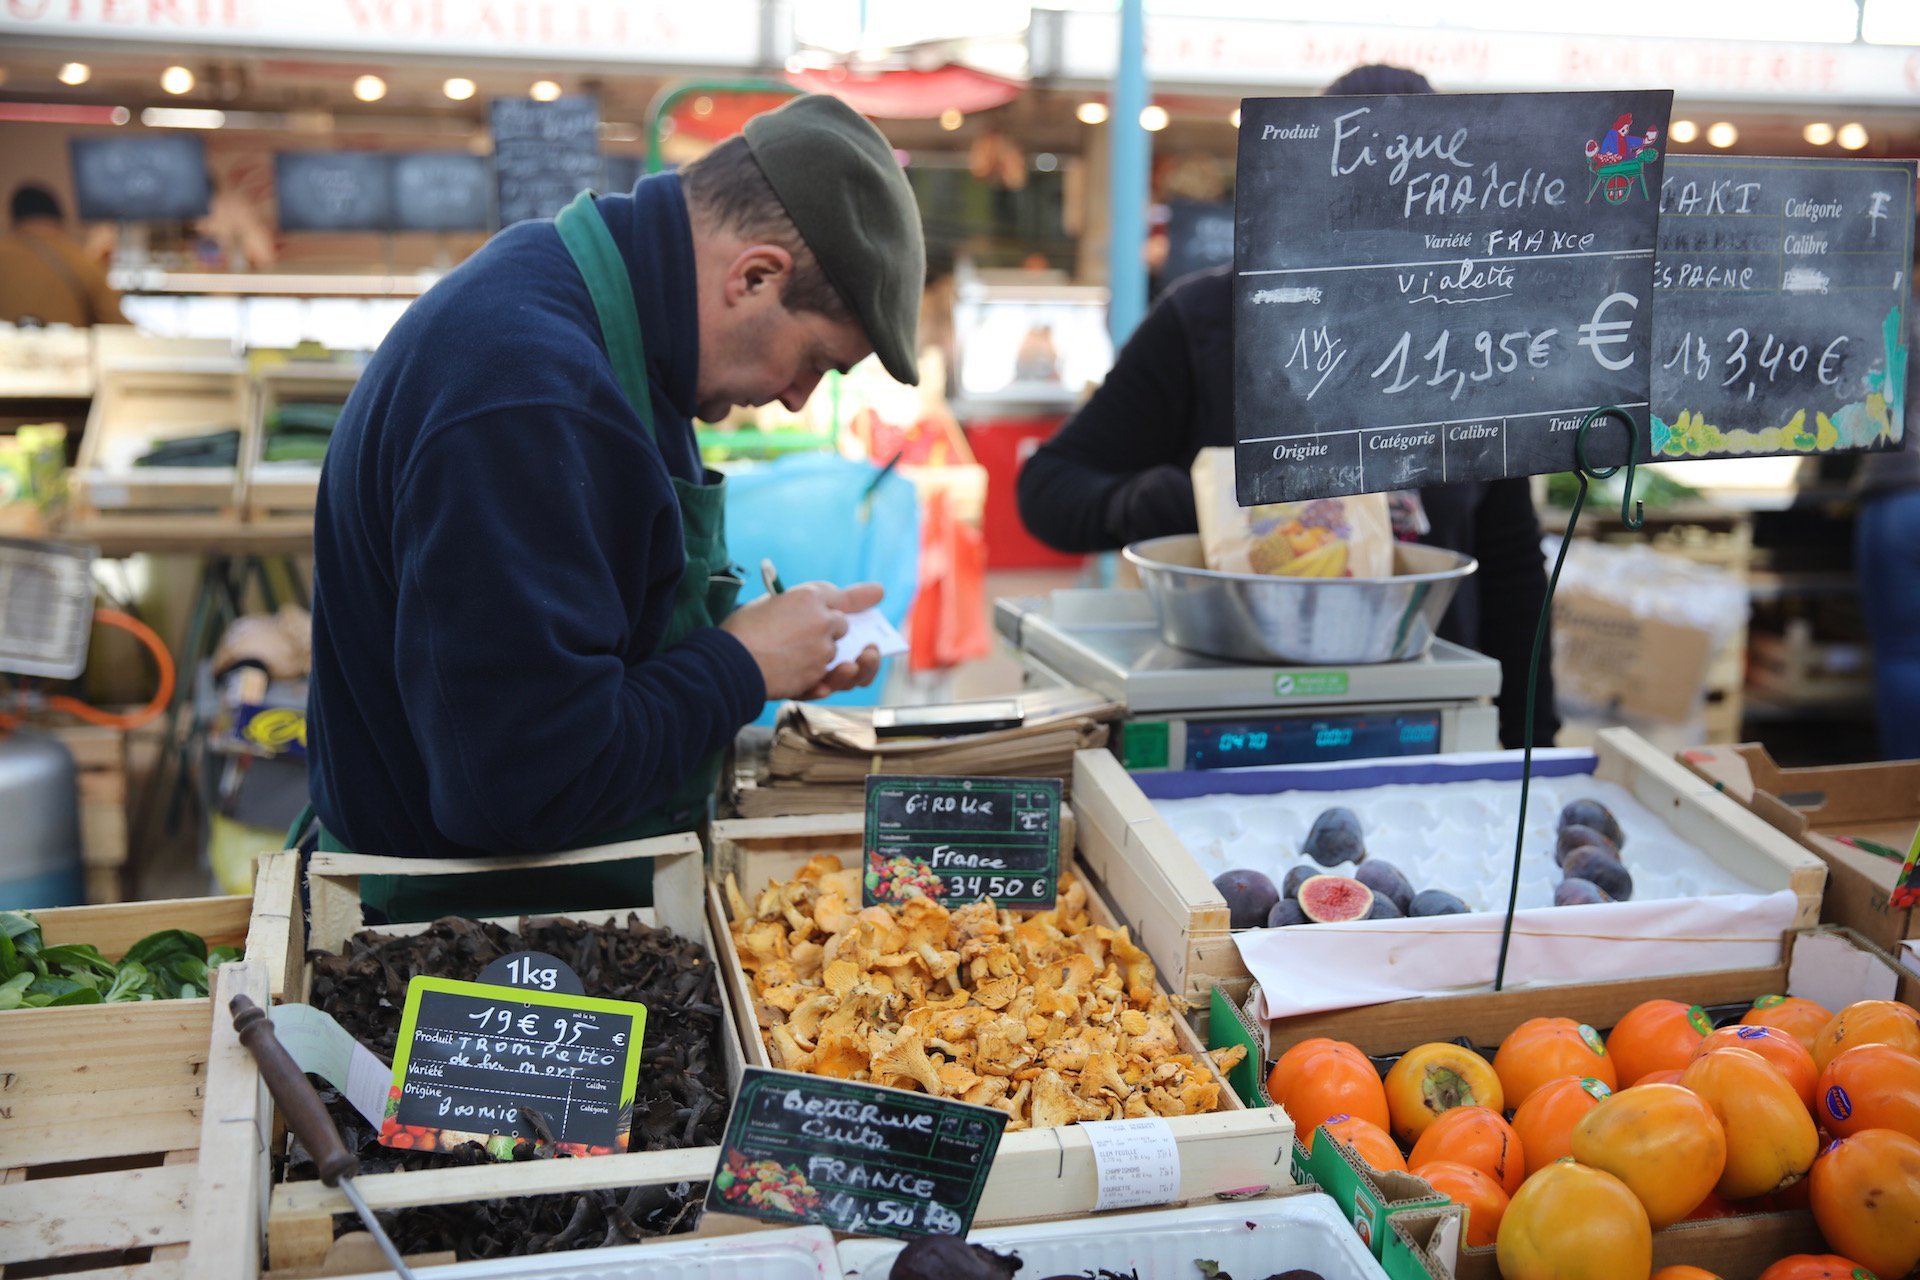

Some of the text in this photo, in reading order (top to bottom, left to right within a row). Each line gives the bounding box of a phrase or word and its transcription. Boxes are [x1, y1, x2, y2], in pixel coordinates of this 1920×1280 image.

[1260, 123, 1319, 141] Produit
[1330, 107, 1474, 185] Figue
[1785, 198, 1842, 222] Catégorie
[1424, 232, 1472, 250] Variété
[1784, 235, 1827, 255] Calibre
[1577, 292, 1640, 371] €
[1272, 443, 1328, 461] Origine
[1369, 431, 1436, 452] Catégorie
[1449, 424, 1499, 441] Calibre
[932, 845, 1007, 869] France
[1032, 879, 1046, 897] €
[506, 957, 558, 990] 1kg
[414, 1030, 454, 1045] Produit
[612, 1032, 626, 1046] €
[408, 1064, 444, 1078] Variété
[404, 1083, 443, 1099] Origine
[585, 1082, 608, 1091] Calibre
[580, 1104, 610, 1115] Catégorie
[807, 1155, 935, 1199] FRANCE
